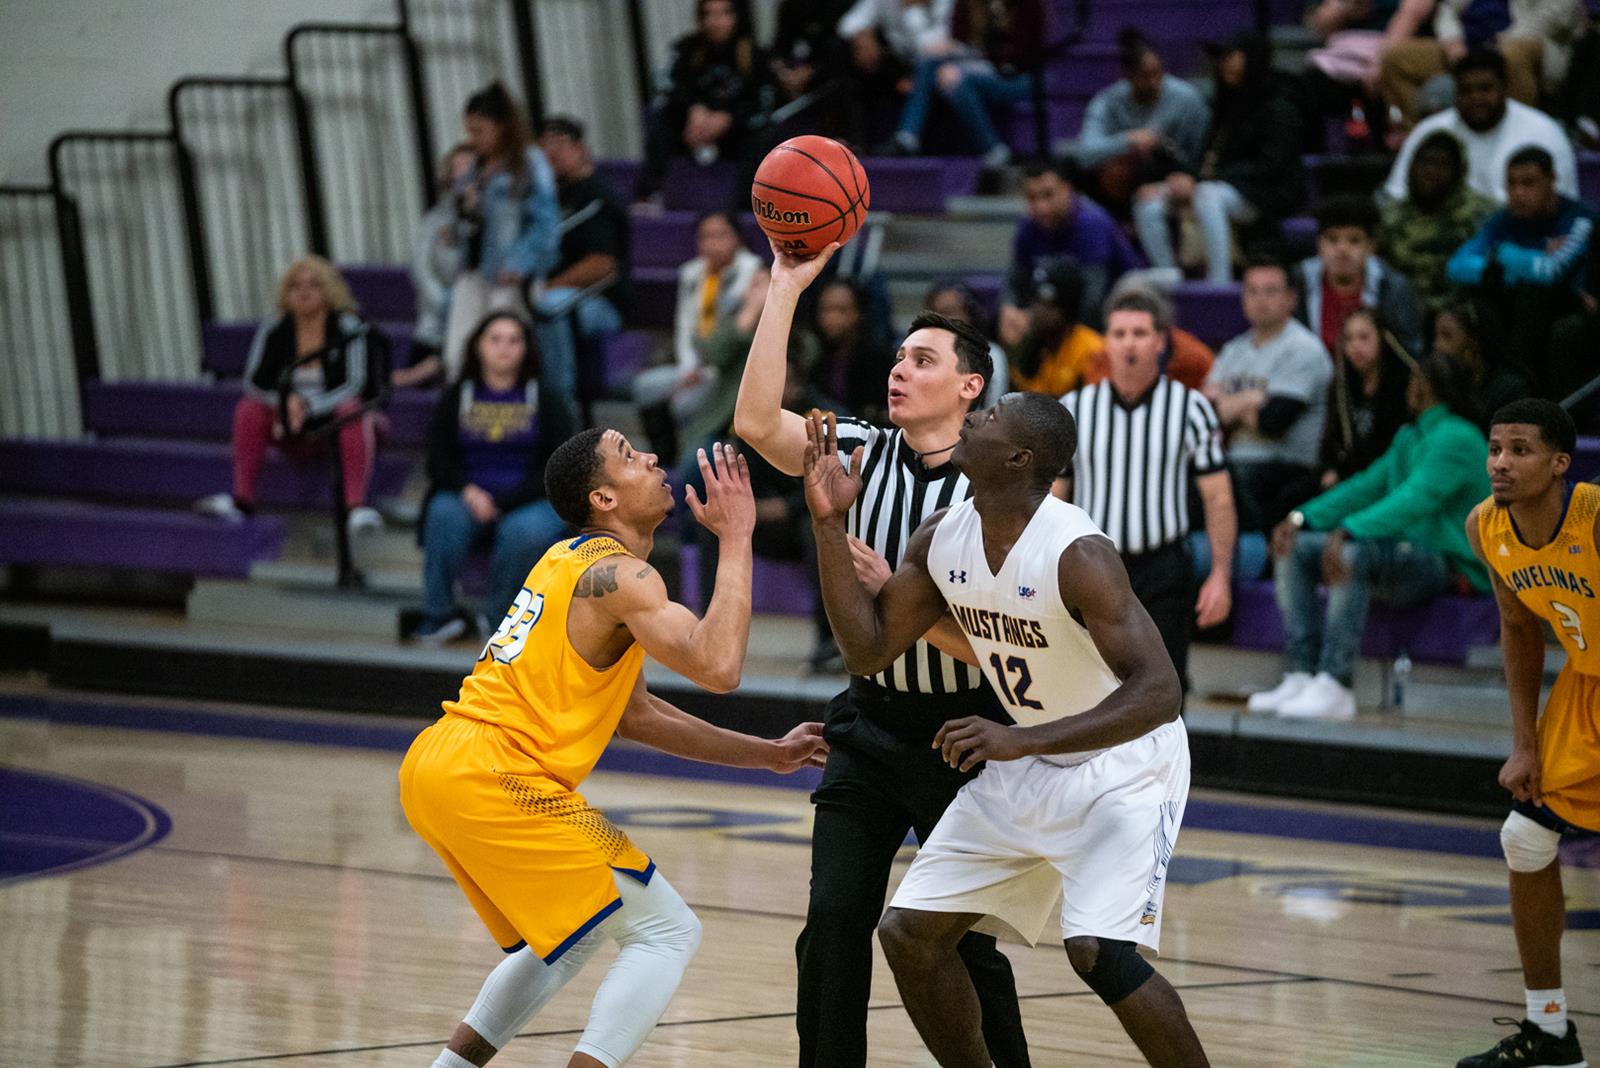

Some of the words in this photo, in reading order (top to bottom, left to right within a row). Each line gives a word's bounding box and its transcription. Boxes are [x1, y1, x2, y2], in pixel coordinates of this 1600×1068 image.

[753, 195, 811, 224] Wilson
[952, 603, 1049, 648] MUSTANGS
[1550, 600, 1587, 650] 3
[989, 652, 1046, 711] 12
